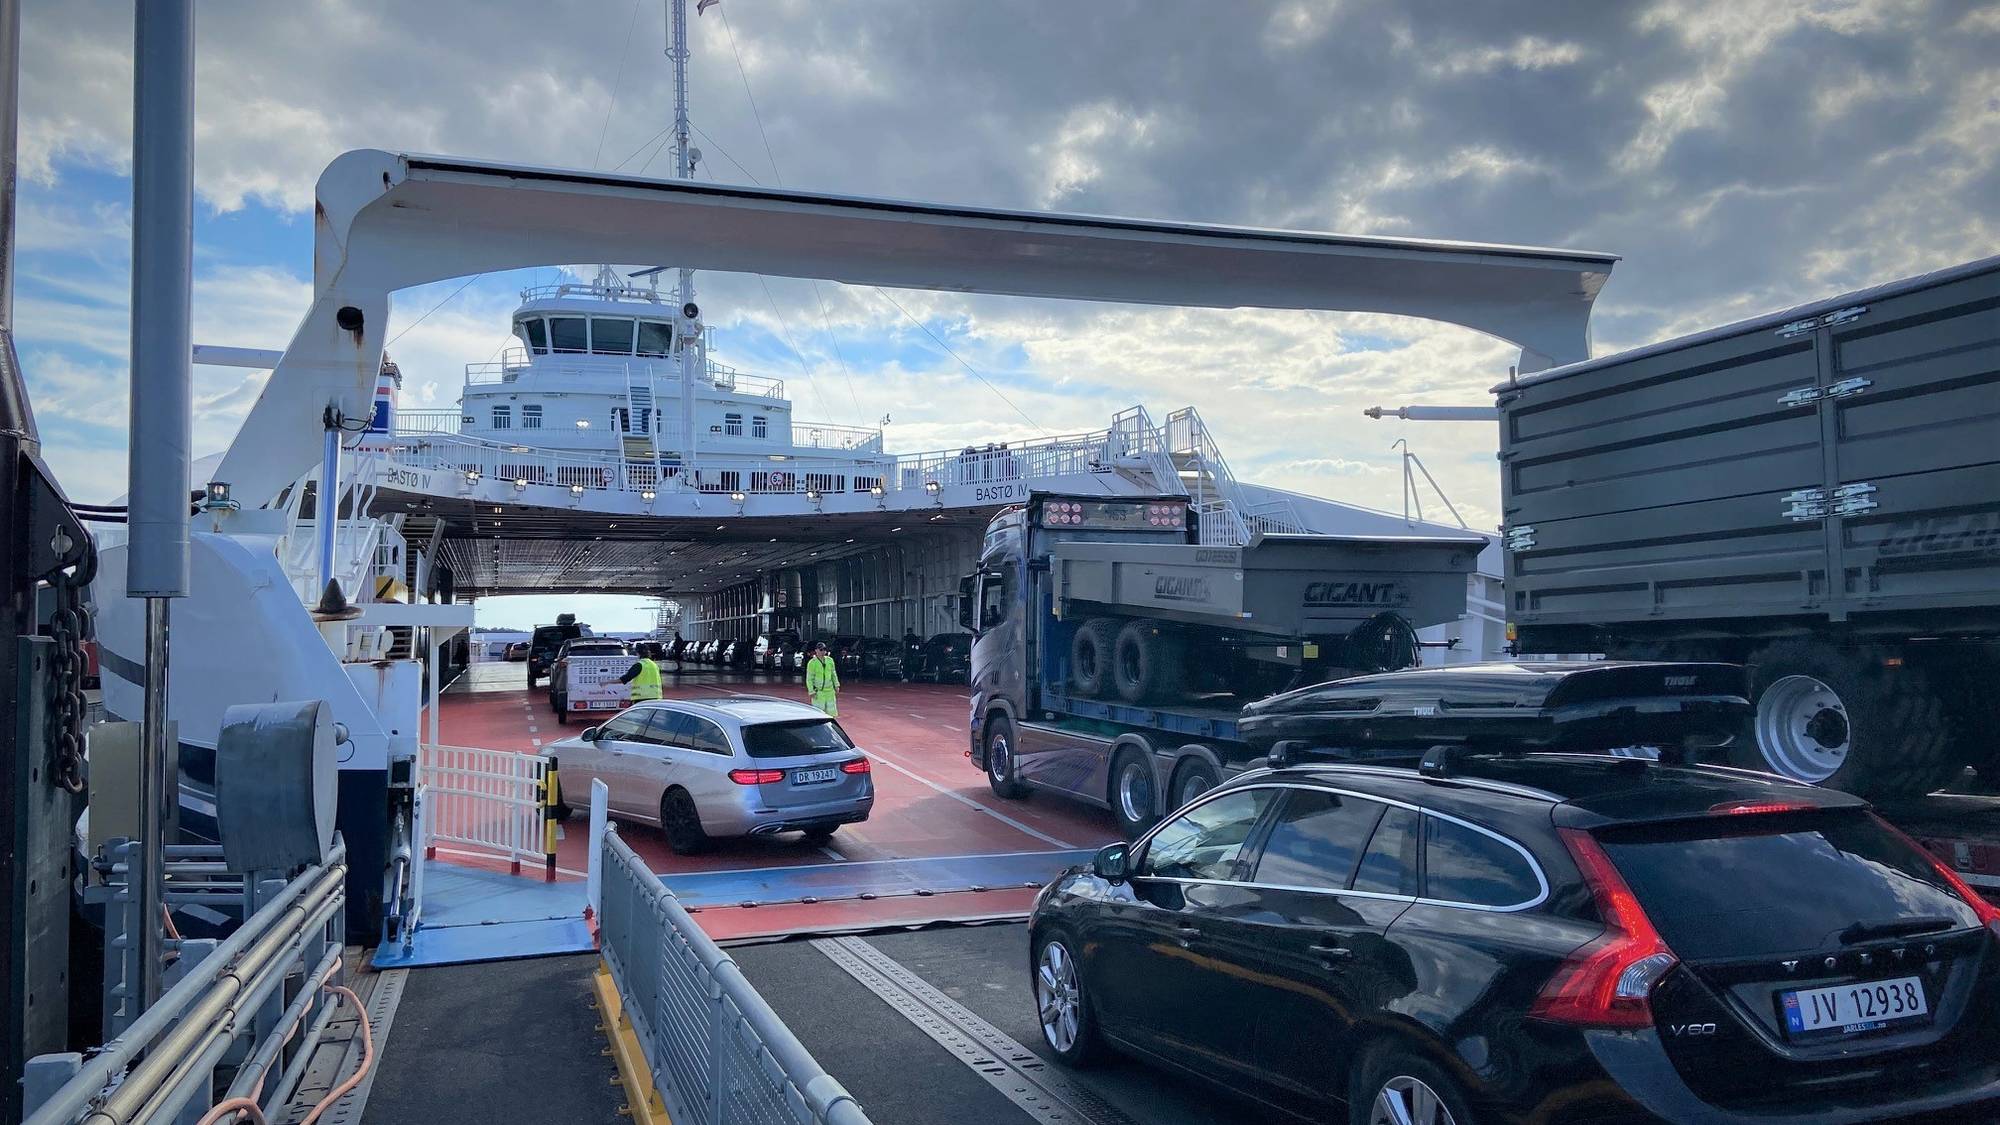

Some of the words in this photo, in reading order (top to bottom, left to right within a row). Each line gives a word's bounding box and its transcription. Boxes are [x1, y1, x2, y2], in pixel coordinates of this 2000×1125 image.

[388, 468, 418, 487] BASTØ
[422, 474, 431, 489] IV
[976, 485, 1013, 501] BASTØ
[1018, 483, 1028, 497] IV
[1303, 582, 1395, 603] GIGANT
[799, 772, 810, 782] DR
[1781, 944, 1935, 972] VOLVO
[1811, 992, 1837, 1025] JV
[1850, 982, 1920, 1018] 12938
[1671, 1023, 1716, 1036] V60
